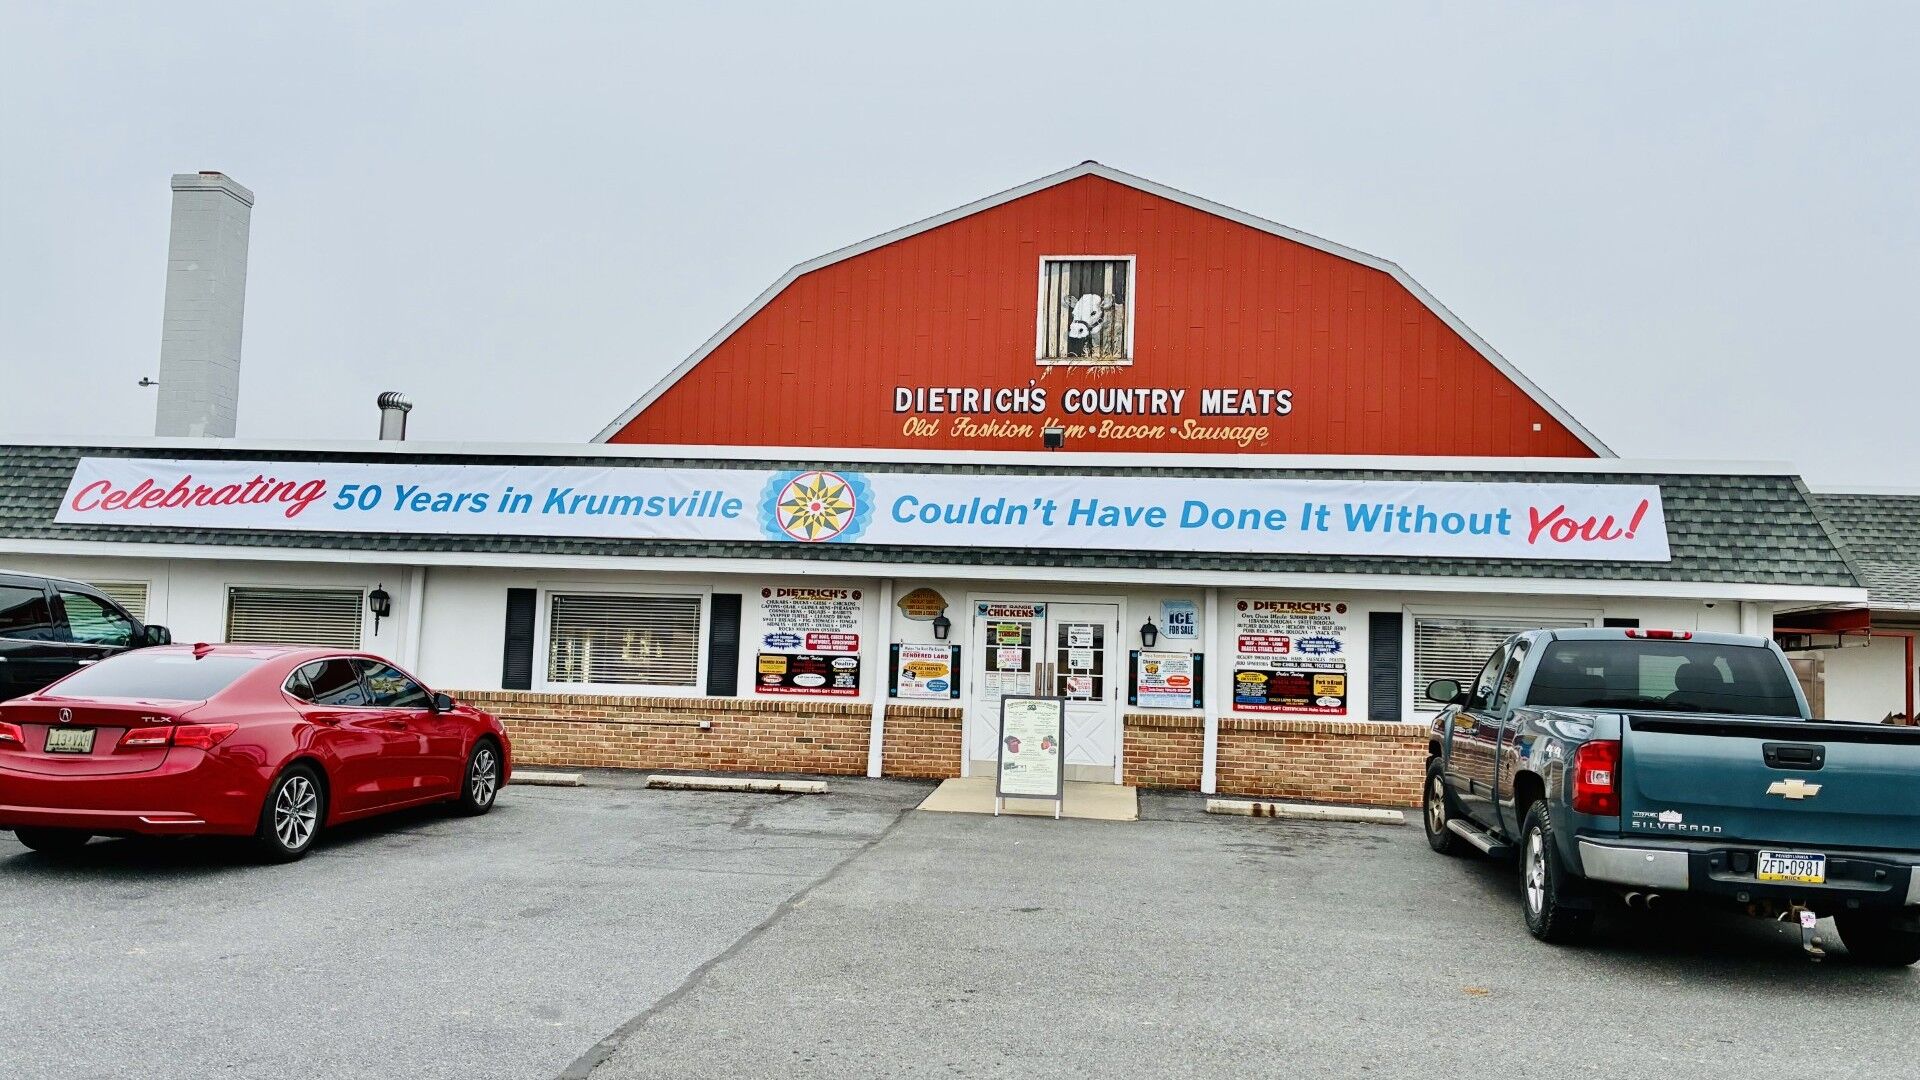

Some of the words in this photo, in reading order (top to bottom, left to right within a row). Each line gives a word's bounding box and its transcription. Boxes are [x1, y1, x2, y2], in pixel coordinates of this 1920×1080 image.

[894, 379, 1046, 413] DIETRICH'S
[1063, 388, 1185, 415] COUNTRY
[1200, 389, 1293, 415] MEATS
[903, 416, 940, 437] Old
[951, 416, 1034, 438] Fashion
[1039, 417, 1086, 438] Hm
[1097, 419, 1166, 440] Bacon
[1178, 418, 1269, 448] Sausage
[72, 476, 327, 518] Celebrating
[333, 485, 382, 511] 50
[393, 485, 490, 513] Years
[498, 487, 533, 514] in
[542, 487, 743, 518] Krumsville
[891, 495, 1057, 526] Couldn't
[1067, 498, 1167, 528] Have
[1179, 501, 1287, 531] Done
[1300, 502, 1330, 532] It
[1344, 504, 1511, 536] Without
[1527, 499, 1649, 545] You!
[777, 588, 848, 600] DIETRICH'S
[1254, 600, 1331, 612] DIETRICH'S
[988, 609, 1034, 618] CHICKENS
[1168, 612, 1194, 624] ICE
[1168, 625, 1180, 634] FOR
[1181, 626, 1194, 635] SALE
[1632, 821, 1722, 833] SILVERADO
[1762, 859, 1819, 877] ZFD-0981
